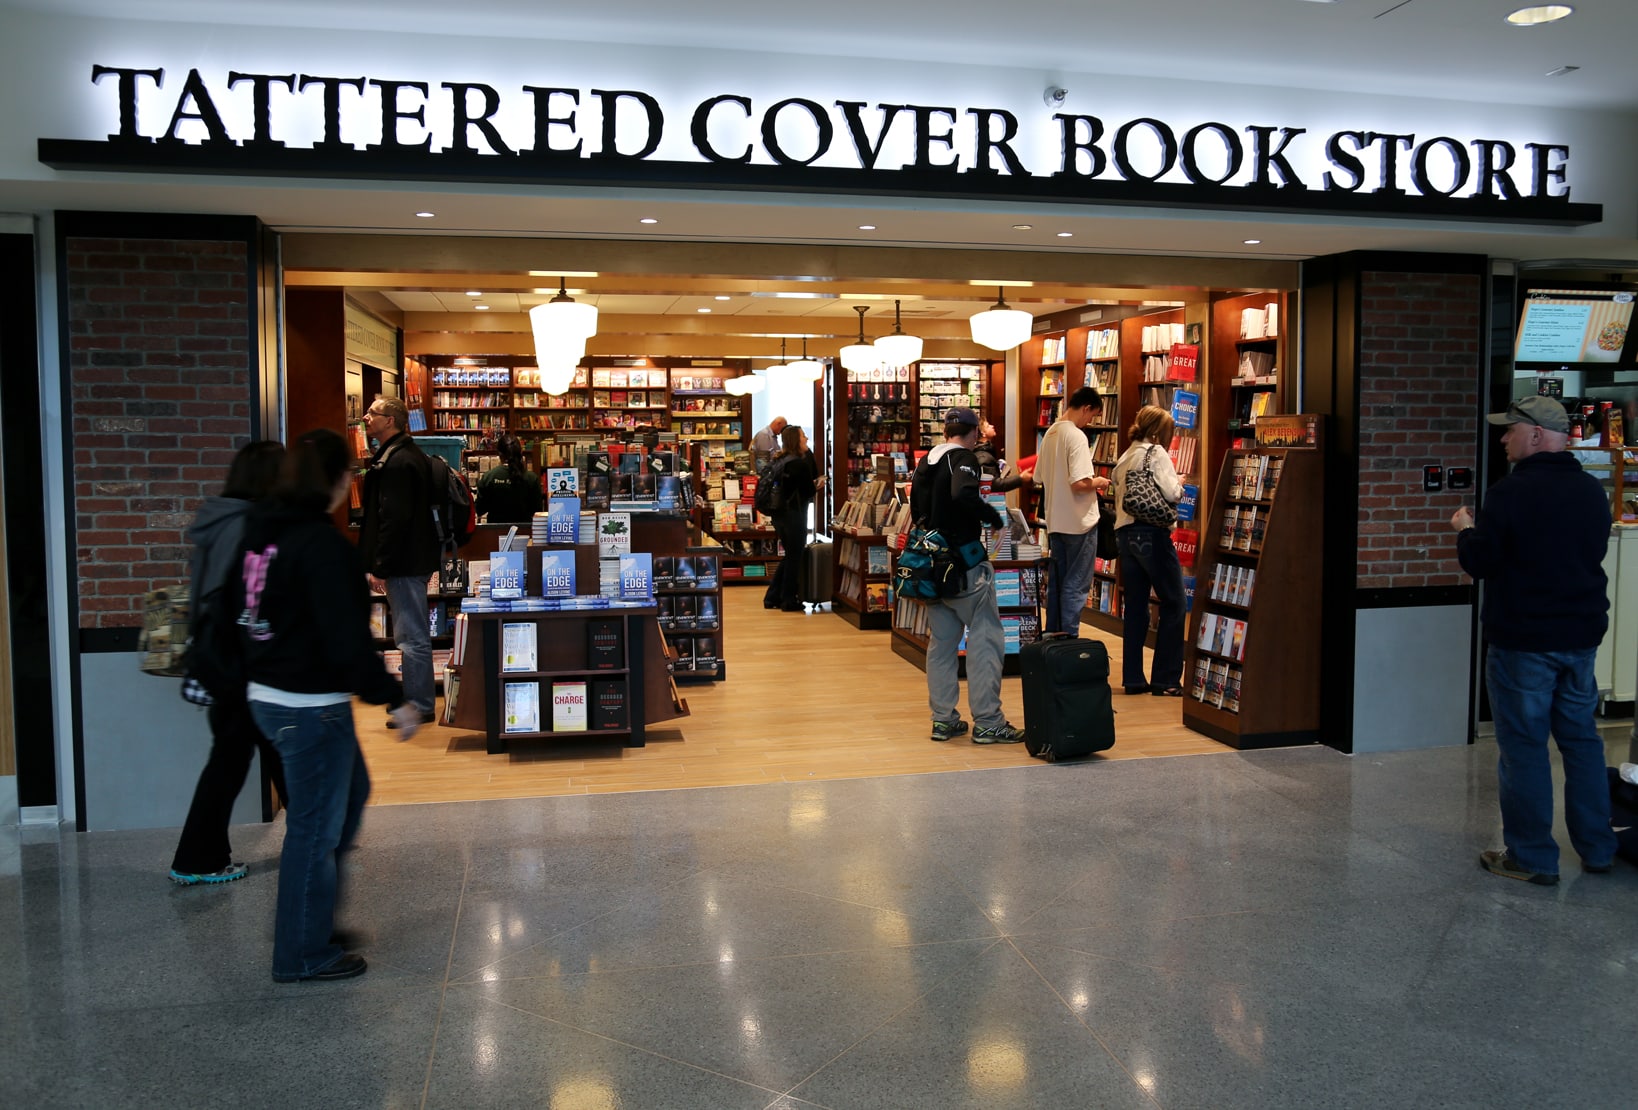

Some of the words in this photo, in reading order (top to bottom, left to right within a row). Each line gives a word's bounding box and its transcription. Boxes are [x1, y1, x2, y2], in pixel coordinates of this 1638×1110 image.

[92, 64, 664, 161] TATTERED
[690, 94, 1032, 177] COVER
[1050, 113, 1307, 191] BOOK
[1322, 130, 1571, 203] STORE
[1173, 356, 1196, 369] GREAT
[1174, 402, 1197, 414] CHOICE
[1180, 496, 1195, 506] OICE
[551, 514, 561, 523] ON
[562, 513, 574, 522] THE
[551, 522, 574, 533] EDGE
[1173, 541, 1196, 554] GREAT
[494, 569, 504, 577] ON
[506, 568, 518, 577] THE
[546, 568, 556, 576] ON
[558, 567, 571, 576] THE
[624, 570, 633, 578] ON
[635, 569, 647, 578] THE
[494, 577, 519, 588] EDGE
[547, 576, 571, 587] EDGE
[624, 577, 648, 589] EDGE
[554, 695, 584, 705] CHARGE
